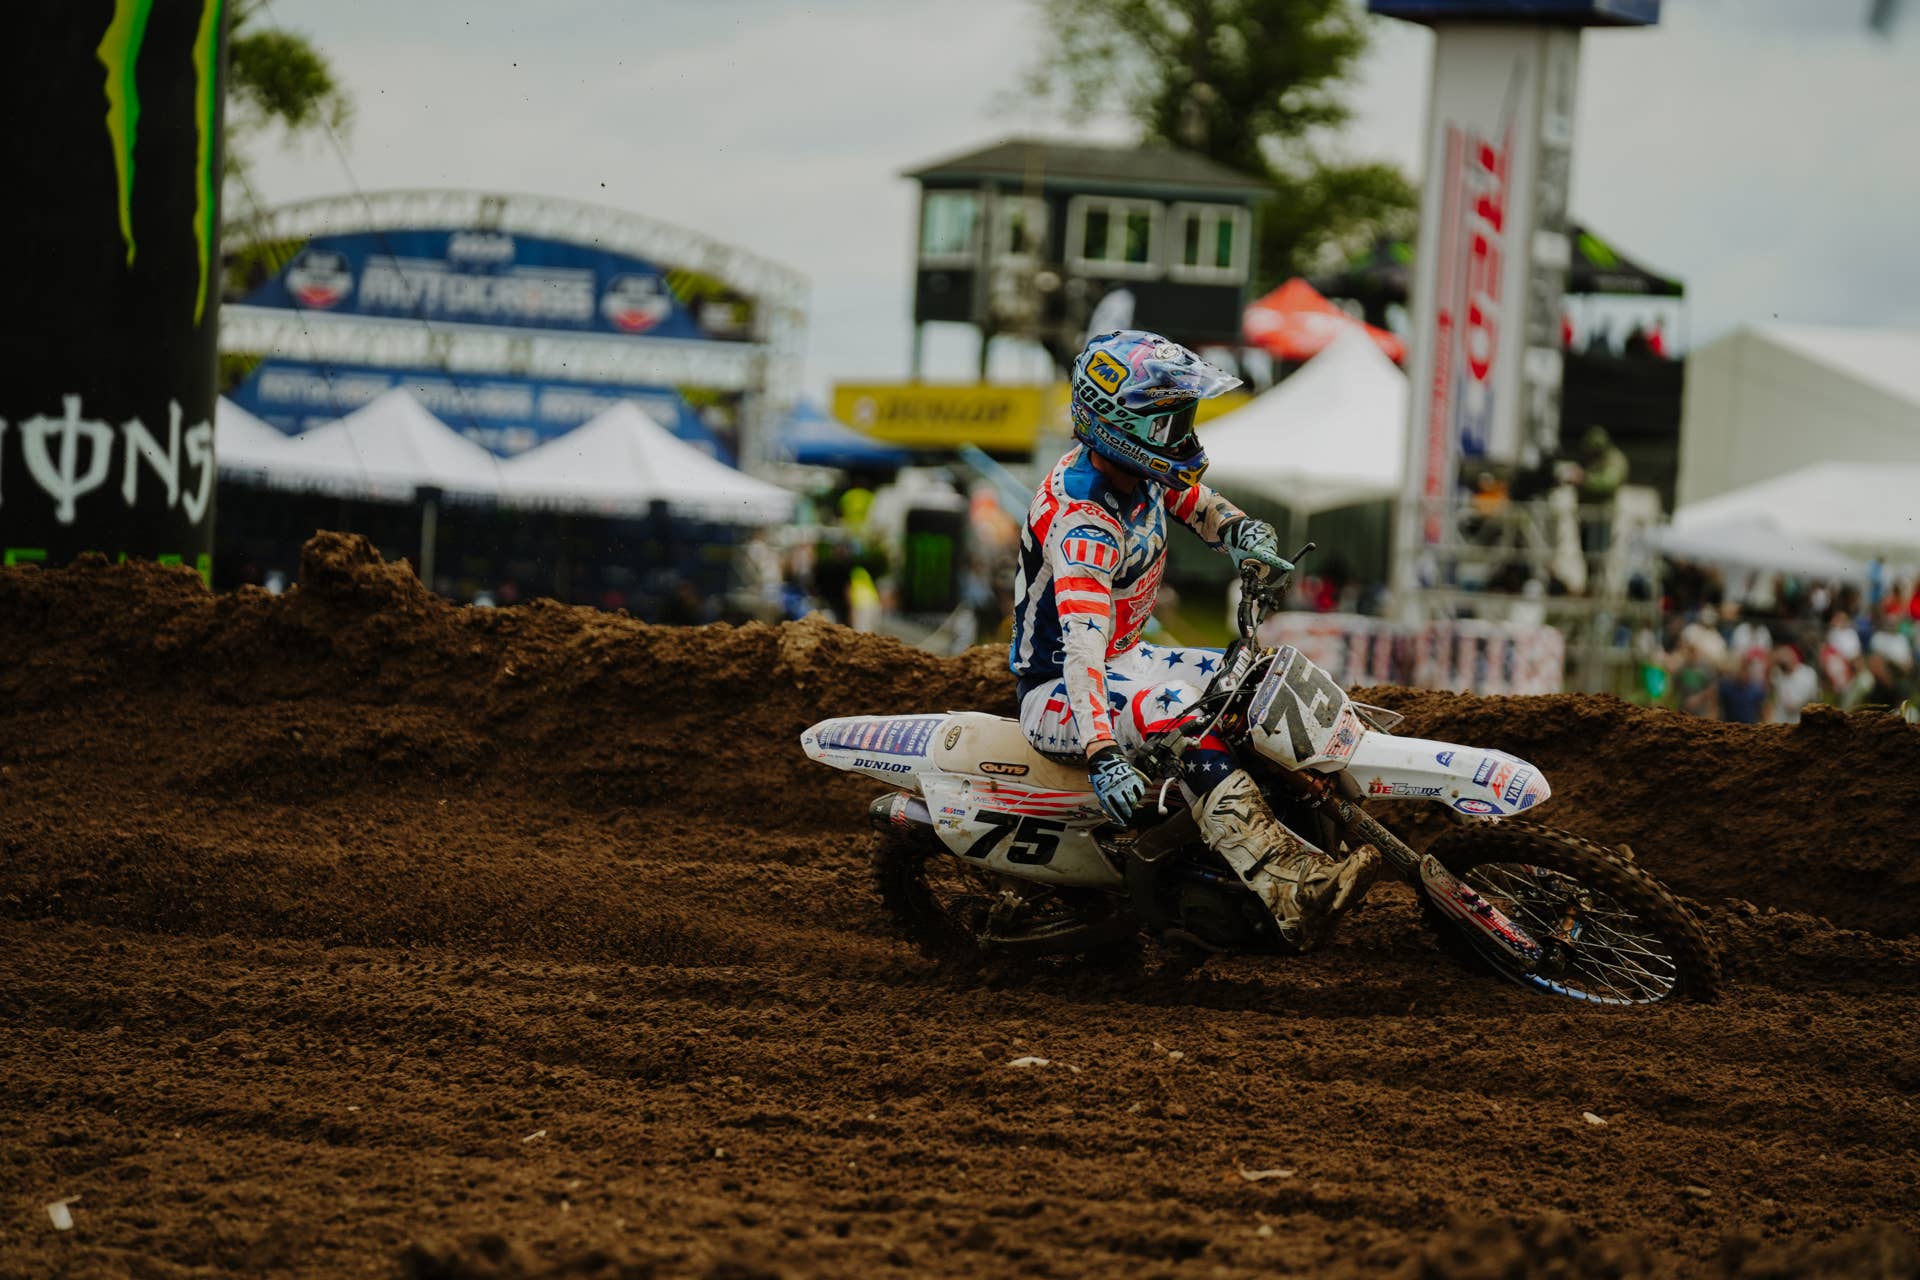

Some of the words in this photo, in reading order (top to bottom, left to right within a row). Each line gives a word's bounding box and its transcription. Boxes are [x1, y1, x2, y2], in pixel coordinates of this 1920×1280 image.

[1077, 376, 1140, 431] 100%
[1096, 425, 1150, 462] mobile
[853, 758, 912, 774] DUNLOP
[981, 763, 1027, 776] GUTS
[964, 809, 1068, 866] 75
